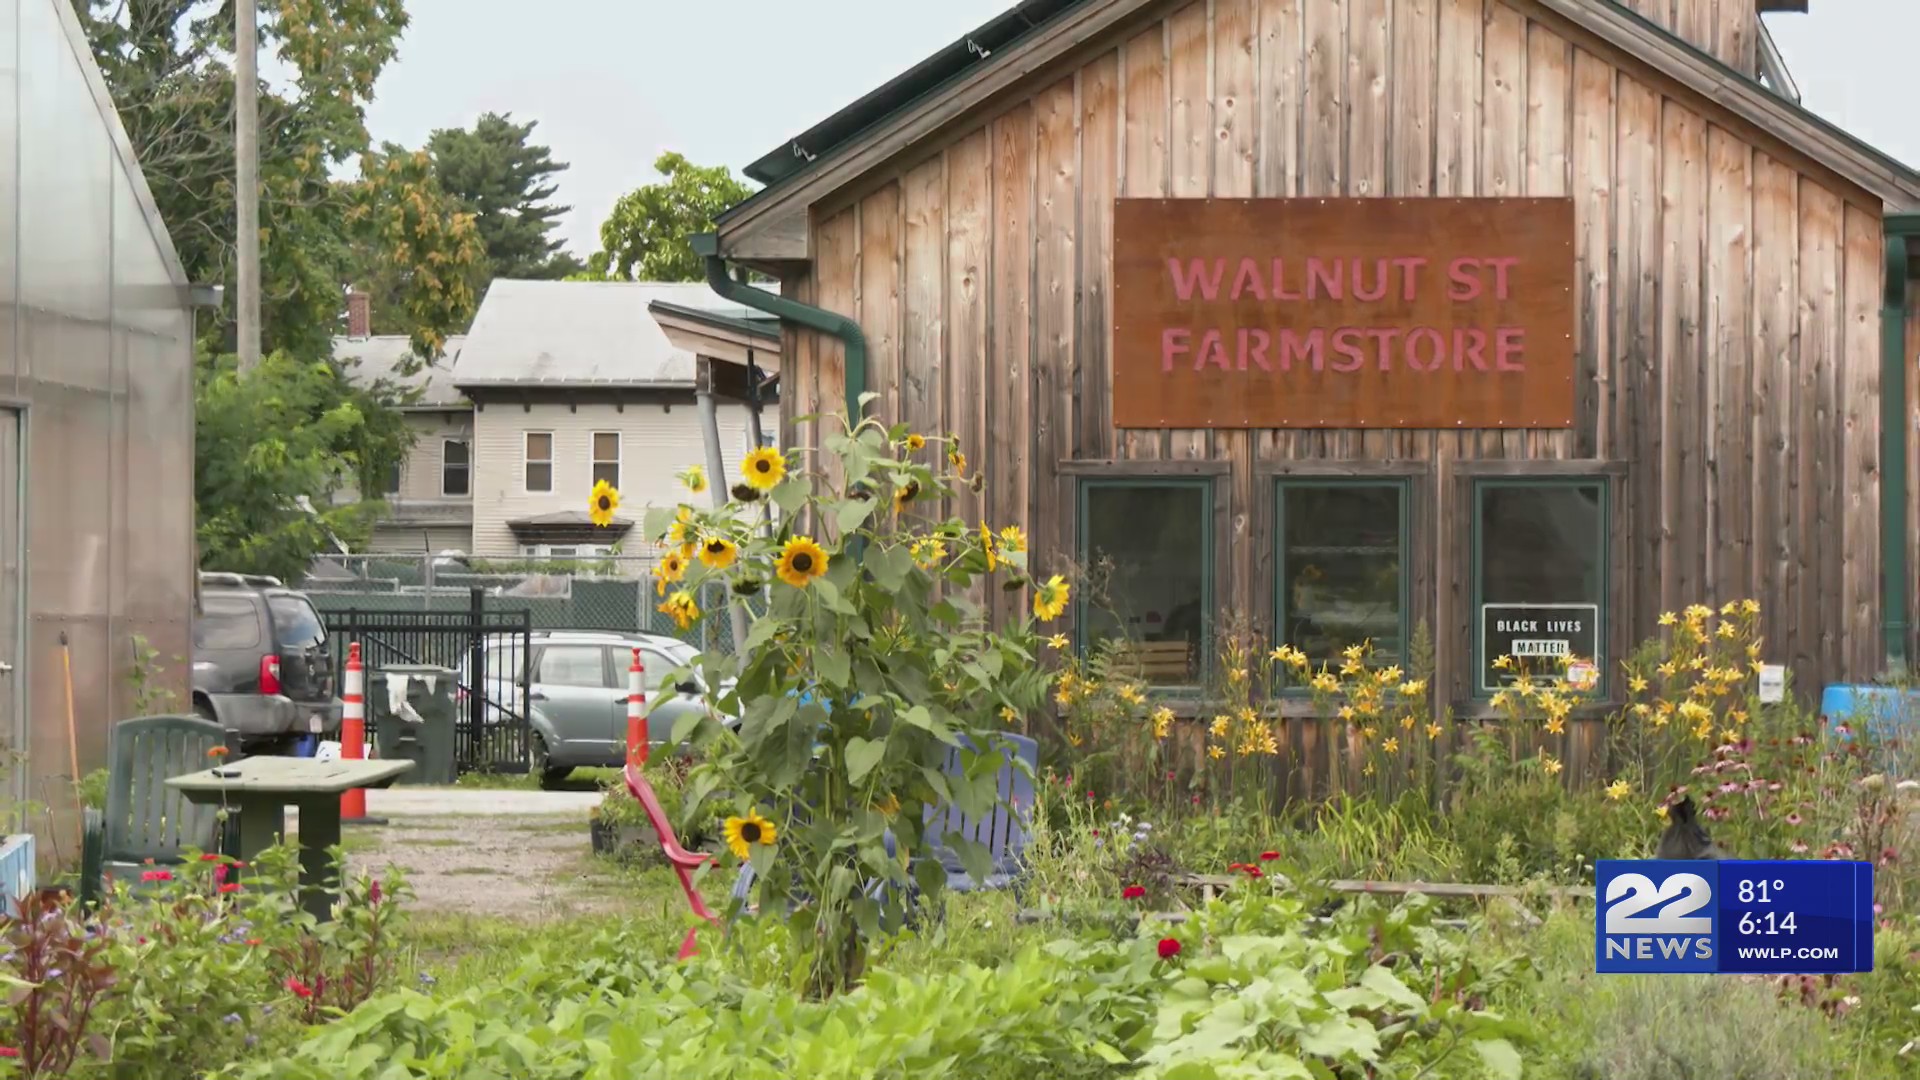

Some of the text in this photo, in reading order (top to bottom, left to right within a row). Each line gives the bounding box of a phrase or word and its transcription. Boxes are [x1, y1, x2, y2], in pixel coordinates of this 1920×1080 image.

[1168, 256, 1520, 302] WALNUT ST
[1161, 327, 1526, 373] FARMSTORE
[1496, 620, 1582, 632] BLACK LIVES
[1517, 642, 1565, 654] MATTER
